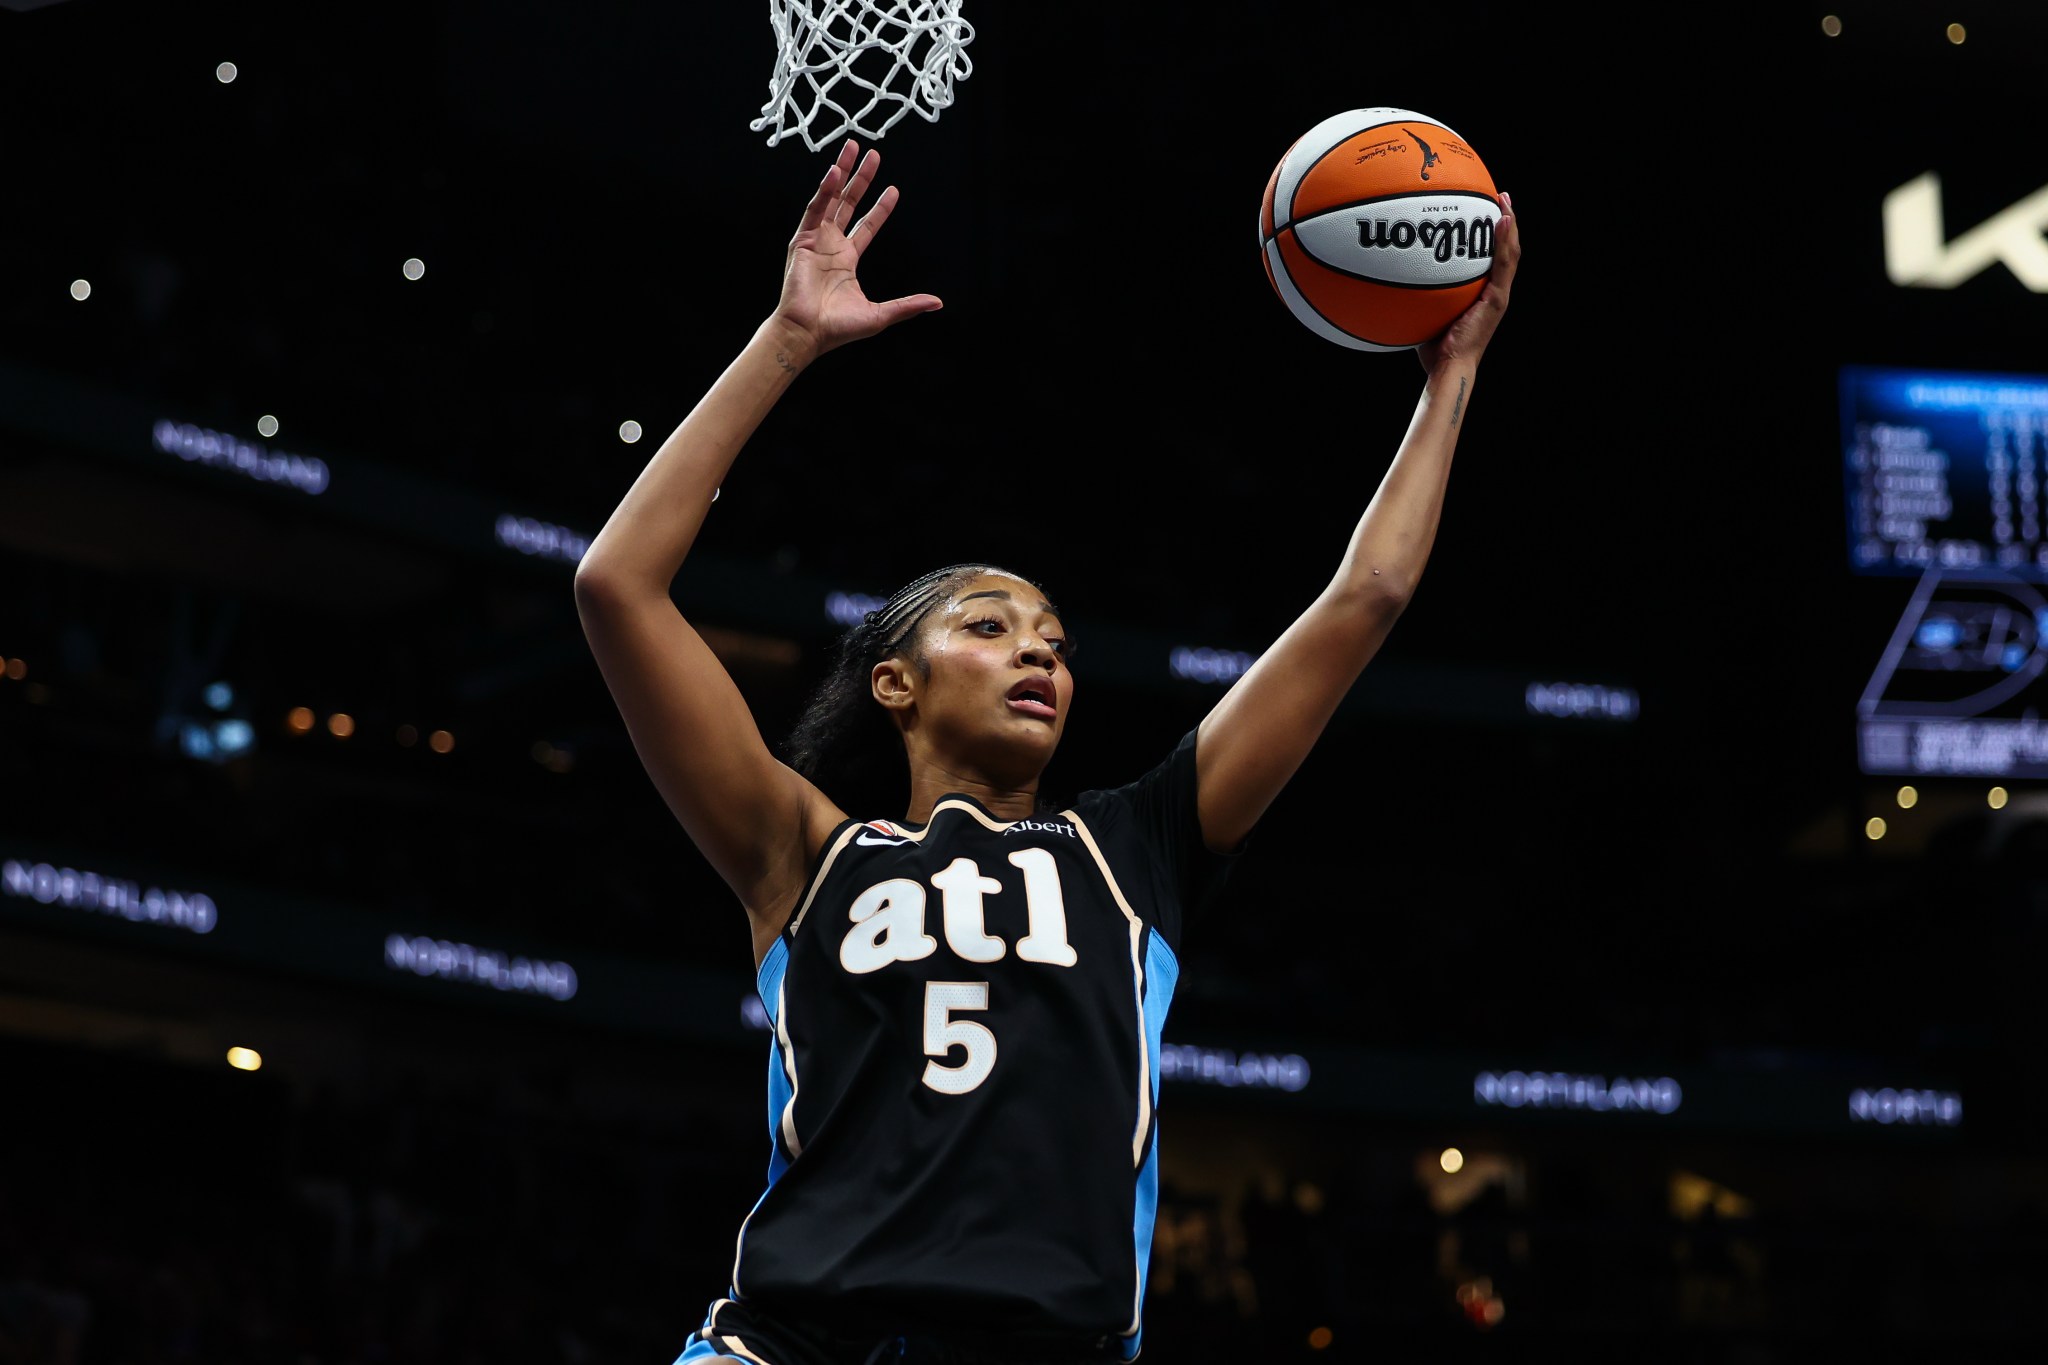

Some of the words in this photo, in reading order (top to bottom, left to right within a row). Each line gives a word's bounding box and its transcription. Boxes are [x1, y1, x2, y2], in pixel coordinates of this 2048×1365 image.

[1356, 216, 1495, 263] Wilson
[153, 418, 330, 495] NORTHLAND
[1003, 820, 1076, 838] Albert
[2, 860, 218, 934] NORTHLAND
[839, 847, 1078, 974] atl
[385, 933, 578, 1001] NORTHLAND
[921, 980, 998, 1095] 5
[1474, 1070, 1683, 1115] NORTHLAND
